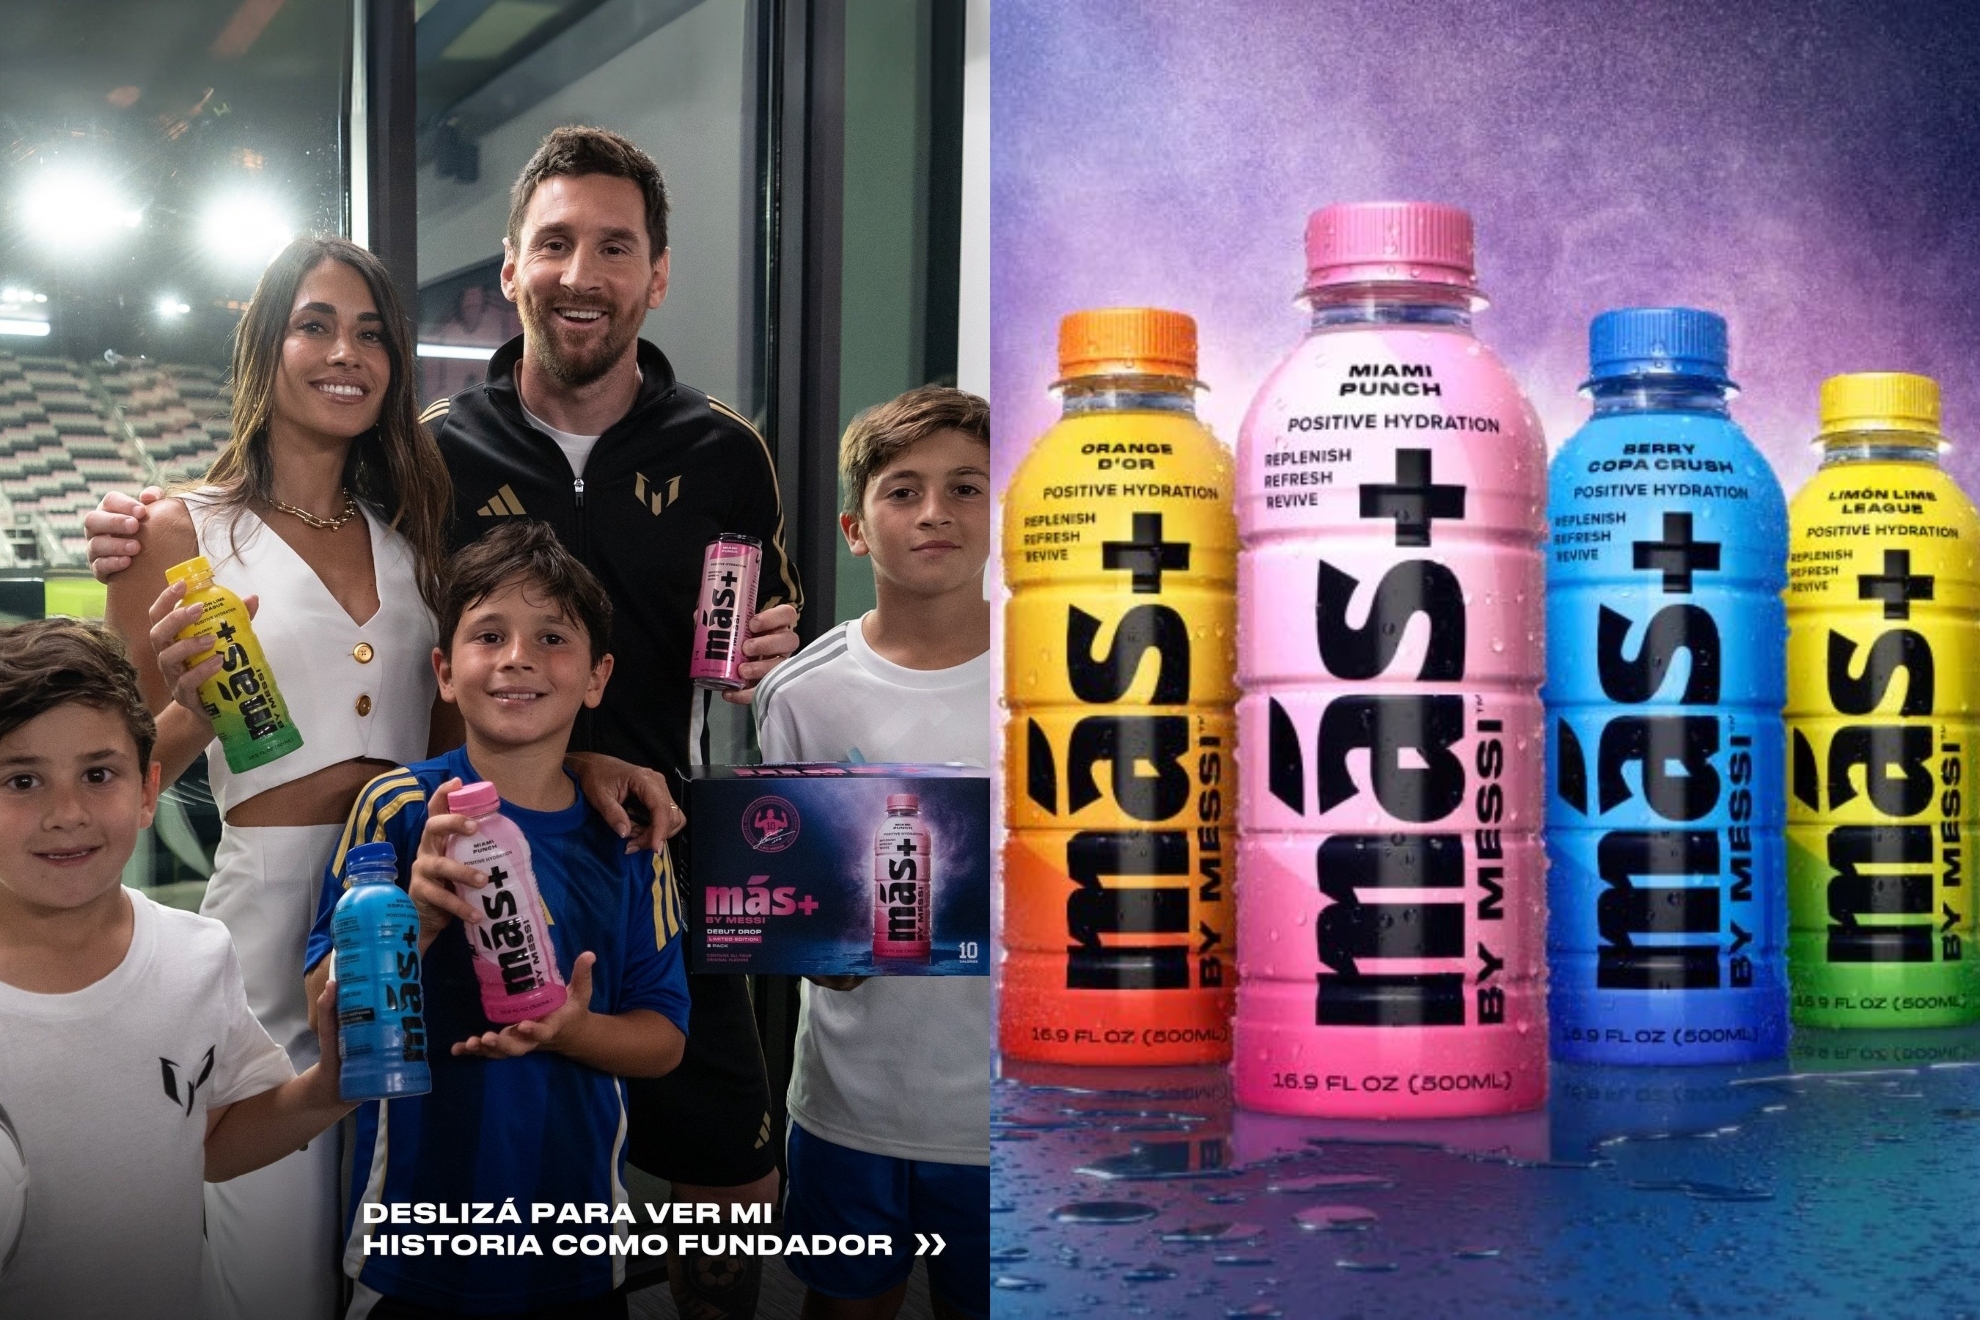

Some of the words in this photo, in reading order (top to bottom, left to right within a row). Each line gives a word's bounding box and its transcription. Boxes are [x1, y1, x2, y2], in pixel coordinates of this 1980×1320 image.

[1349, 364, 1432, 377] MIAMI
[1339, 382, 1442, 396] PUNCH
[1288, 414, 1376, 433] POSITIVE
[1384, 414, 1500, 433] HYDRATION
[1081, 443, 1174, 455] ORANGE
[1623, 443, 1696, 454] BERRY
[1098, 458, 1155, 470] D'OR
[1264, 449, 1352, 467] REPLENISH
[1588, 459, 1649, 473] COPA
[1654, 459, 1734, 473] CRUSH
[1264, 471, 1333, 488] REFRESH
[1043, 483, 1117, 500] POSITIVE
[1123, 483, 1219, 500] HYDRATION
[1574, 484, 1647, 499] POSITIVE
[1653, 484, 1748, 500] HYDRATION
[1828, 486, 1889, 501] LIMÓN
[1893, 490, 1937, 501] LIME
[1266, 492, 1318, 508] REVIVE
[1841, 503, 1923, 514] LEAGUE
[1024, 512, 1096, 528] REPLENISH
[1555, 512, 1626, 527] REPLENISH
[1024, 531, 1080, 546] REFRESH
[1554, 531, 1611, 545] REFRESH
[1806, 524, 1870, 538] POSITIVE
[1875, 524, 1959, 539] HYDRATION
[1026, 549, 1068, 562] REVIVE
[1556, 549, 1599, 563] REVIVE
[1791, 549, 1853, 562] REPLENISH
[1791, 565, 1838, 577] REFRESH
[1791, 580, 1828, 592] REVIVE
[255, 669, 277, 709] MESSI
[1198, 736, 1222, 902] MESSI
[1476, 719, 1504, 921] MESSI
[1730, 735, 1753, 902] MESSI
[1941, 742, 1962, 887] MESSI
[472, 844, 498, 854] PUNCH
[473, 839, 495, 849] MIAMI
[706, 916, 722, 924] BY
[726, 916, 766, 924] MESSI
[1941, 903, 1963, 962] BY
[523, 919, 540, 965] MESSI
[959, 941, 978, 959] 10
[1198, 920, 1222, 989] BY
[1730, 922, 1753, 989] BY
[535, 970, 546, 987] BY
[1476, 941, 1505, 1025] BY
[1835, 997, 1857, 1009] FL
[1860, 997, 1887, 1009] OZ
[1893, 993, 1967, 1012] (500ML)
[1032, 1027, 1069, 1042] 16.9
[1074, 1029, 1101, 1043] FL
[1104, 1029, 1135, 1043] OZ
[1142, 1027, 1229, 1047] (500ML)
[1605, 1029, 1632, 1043] FL
[1635, 1029, 1665, 1043] OZ
[1673, 1027, 1759, 1047] (500ML)
[1273, 1073, 1318, 1090] 16.9
[1326, 1075, 1356, 1091] FL
[1362, 1075, 1398, 1092] OZ
[1408, 1071, 1512, 1095] (500ML)
